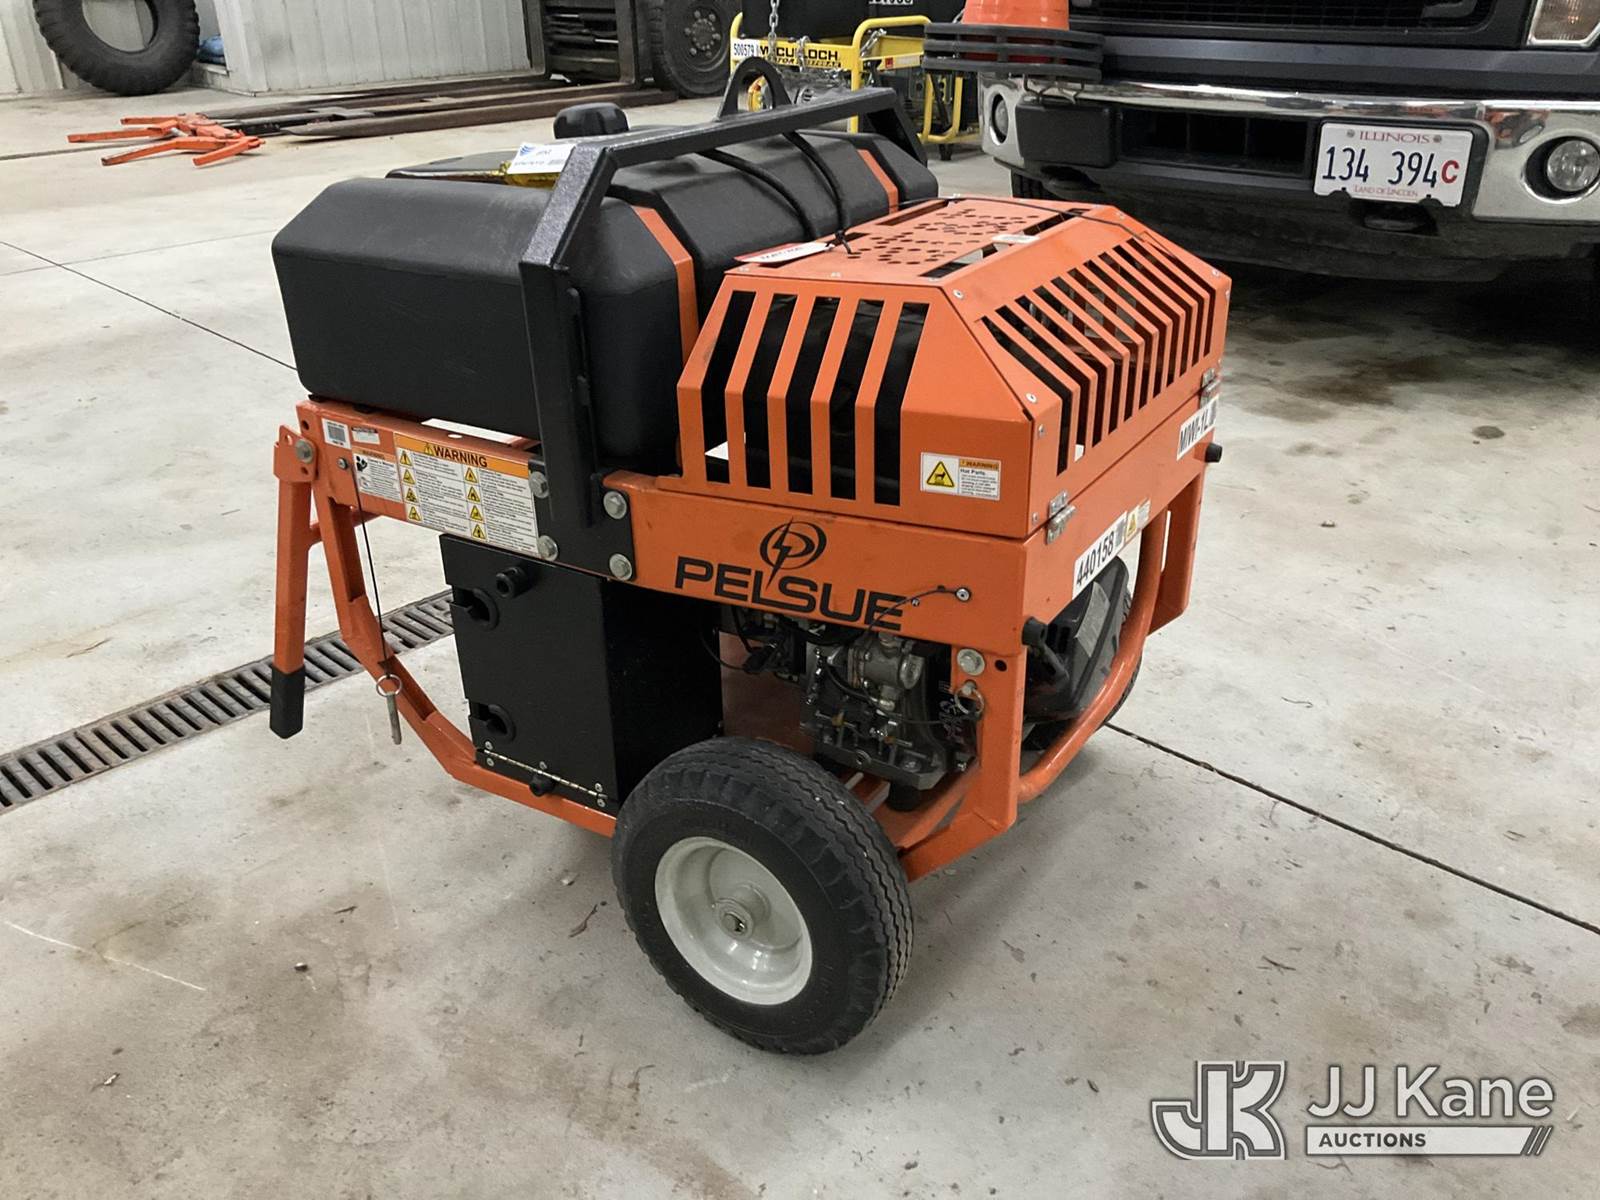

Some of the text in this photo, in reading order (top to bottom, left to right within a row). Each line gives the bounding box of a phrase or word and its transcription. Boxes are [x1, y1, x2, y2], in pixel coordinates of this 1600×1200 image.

[1359, 130, 1430, 144] ILLINOIS
[1321, 146, 1369, 183] 134
[434, 444, 488, 468] WARNING
[1076, 530, 1115, 586] 440158
[674, 555, 907, 631] PELSUE
